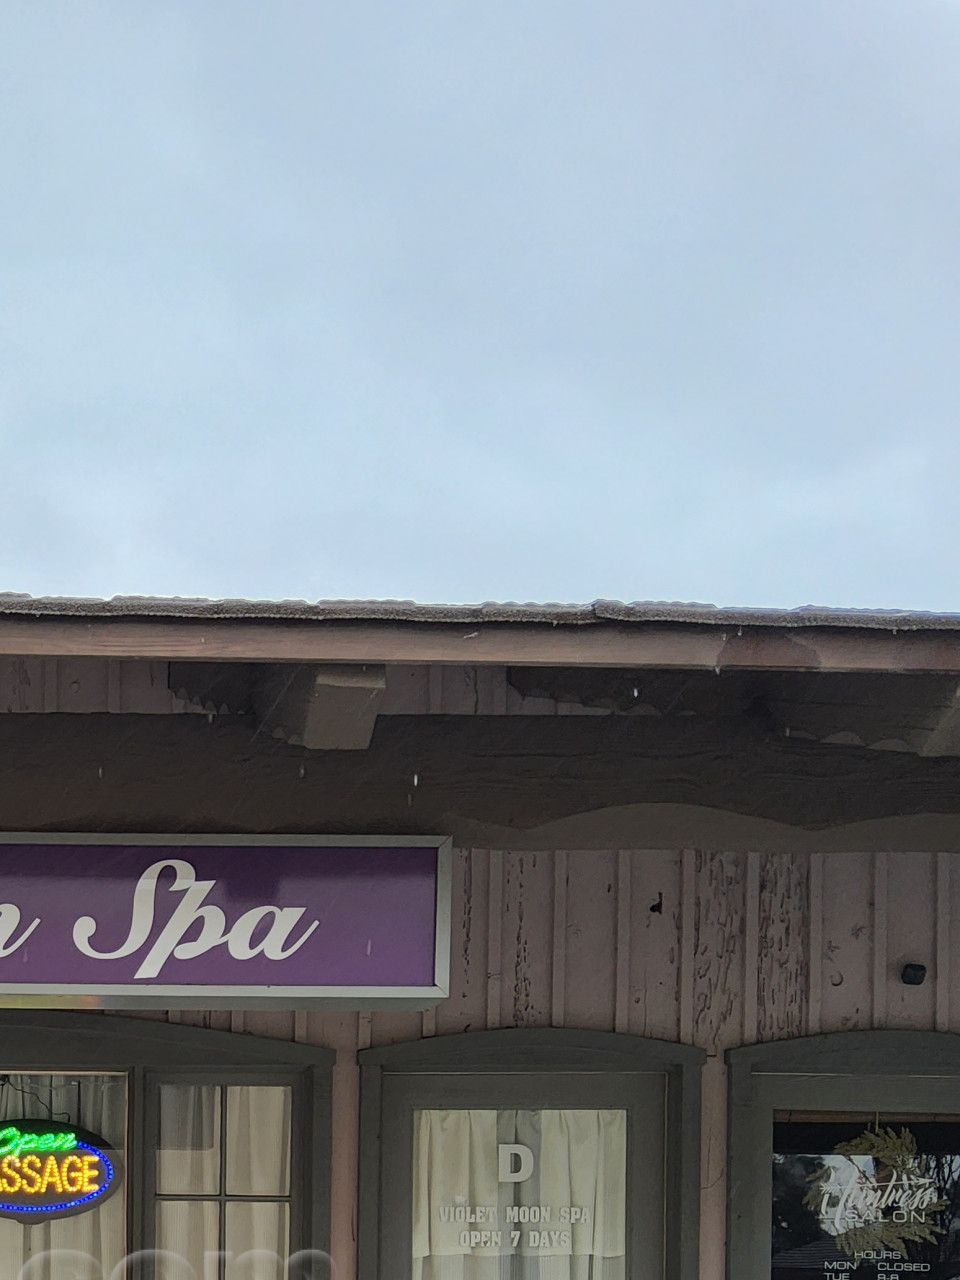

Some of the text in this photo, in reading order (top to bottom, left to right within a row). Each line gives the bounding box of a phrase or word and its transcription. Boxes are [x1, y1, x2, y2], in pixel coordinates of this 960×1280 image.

[73, 859, 320, 979] Spa
[498, 1143, 534, 1183] D
[440, 1206, 590, 1224] VIOLET MOON SPA
[845, 1210, 926, 1223] SALON
[459, 1230, 570, 1247] OPEN 7 DAYS
[854, 1251, 902, 1260] HOURS
[824, 1261, 931, 1272] MON CLOSED
